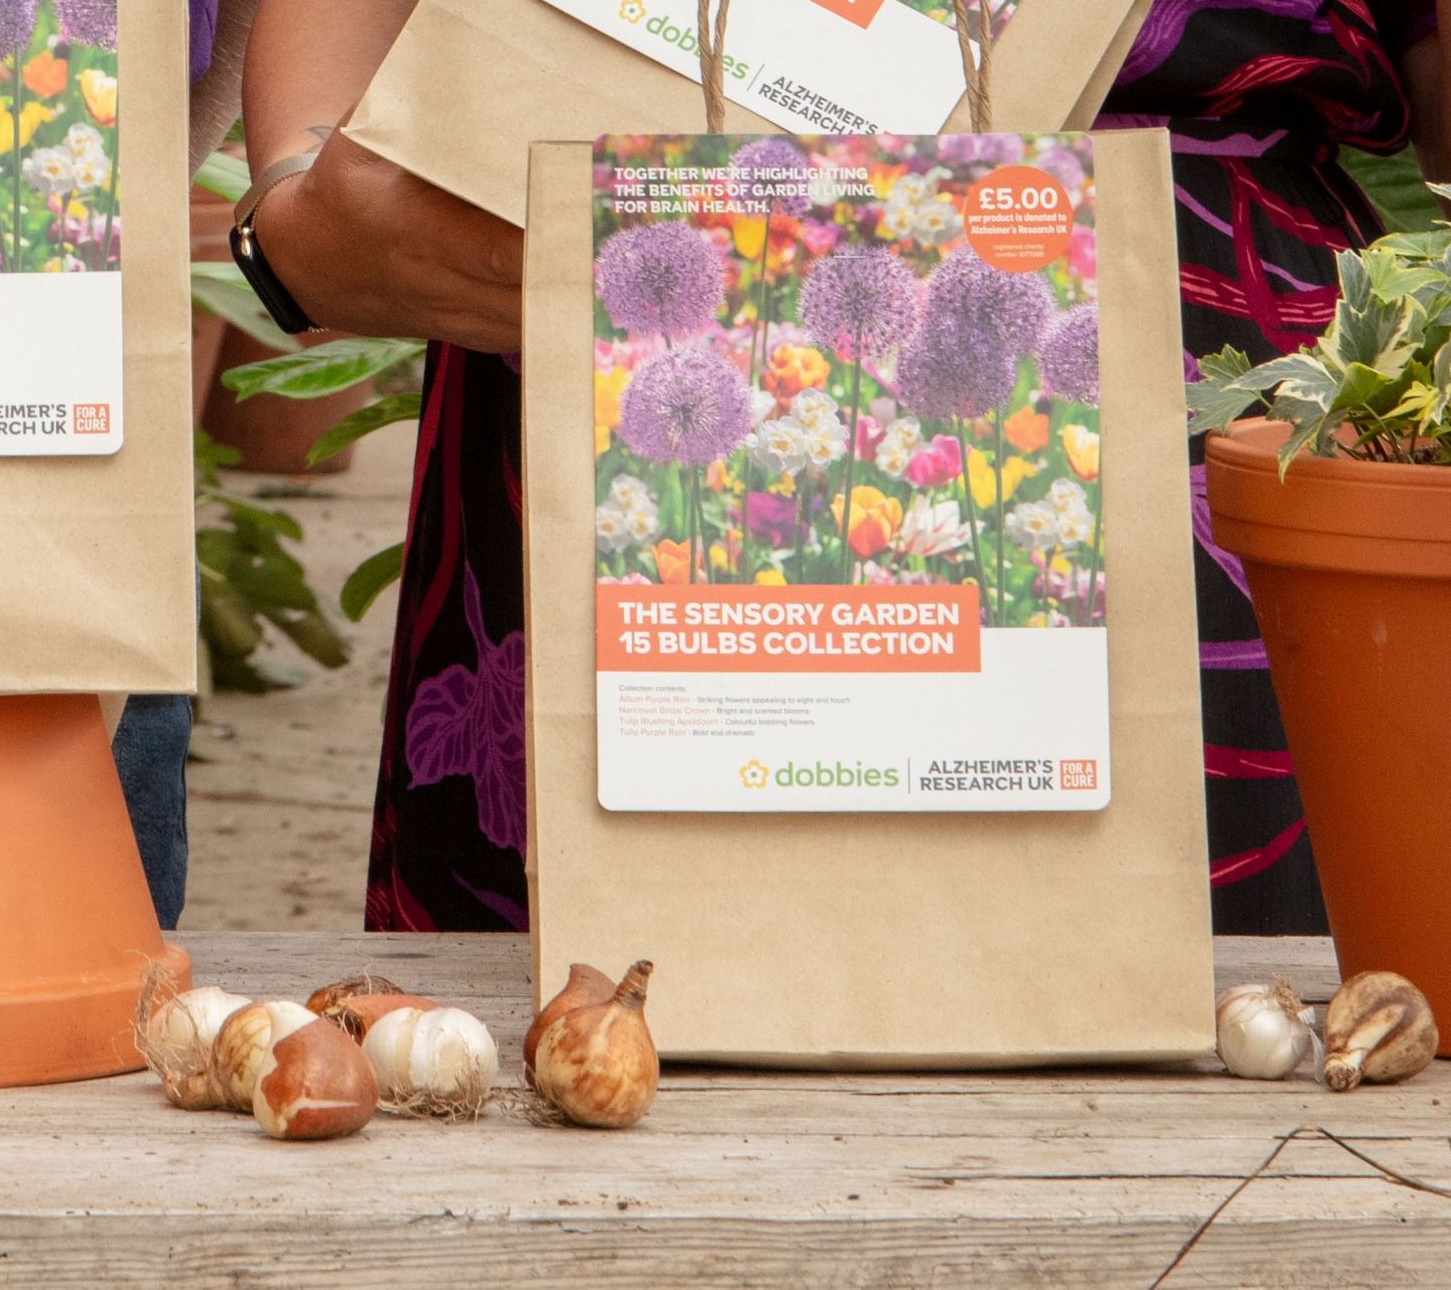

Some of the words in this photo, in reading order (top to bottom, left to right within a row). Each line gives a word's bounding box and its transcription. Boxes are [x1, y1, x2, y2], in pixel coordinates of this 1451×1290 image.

[645, 12, 751, 80] dobes
[757, 82, 848, 134] RESEARCH
[772, 73, 879, 135] ALZHEIMER'S
[614, 167, 698, 180] TOGETHER
[701, 168, 750, 180] WE'RE
[754, 168, 867, 180] HIGHLIGHTING
[614, 184, 645, 196] THE
[649, 184, 724, 196] BENEFITS
[727, 184, 747, 196] OF
[752, 184, 820, 196] GARDEN
[824, 184, 874, 197] LIVING
[979, 187, 1057, 210] £5.00
[614, 200, 648, 212] FOR
[651, 200, 698, 213] BRAIN
[703, 200, 769, 213] HEALTH.
[76, 406, 95, 418] FOR
[97, 406, 106, 417] A
[41, 420, 66, 435] UK
[76, 418, 107, 430] CURE
[617, 602, 676, 625] THE
[684, 602, 824, 625] SENSORY
[831, 602, 958, 625] GARDEN
[618, 631, 651, 654] 15
[658, 631, 756, 654] BULBS
[763, 631, 953, 655] COLLECTION
[774, 761, 899, 787] dobbies
[928, 760, 1053, 774] ALZHEIMER'S
[1063, 762, 1082, 773] FOR
[1084, 762, 1093, 773] A
[920, 776, 1024, 791] RESEARCH
[1028, 776, 1053, 791] UK
[1063, 774, 1094, 786] CURE
